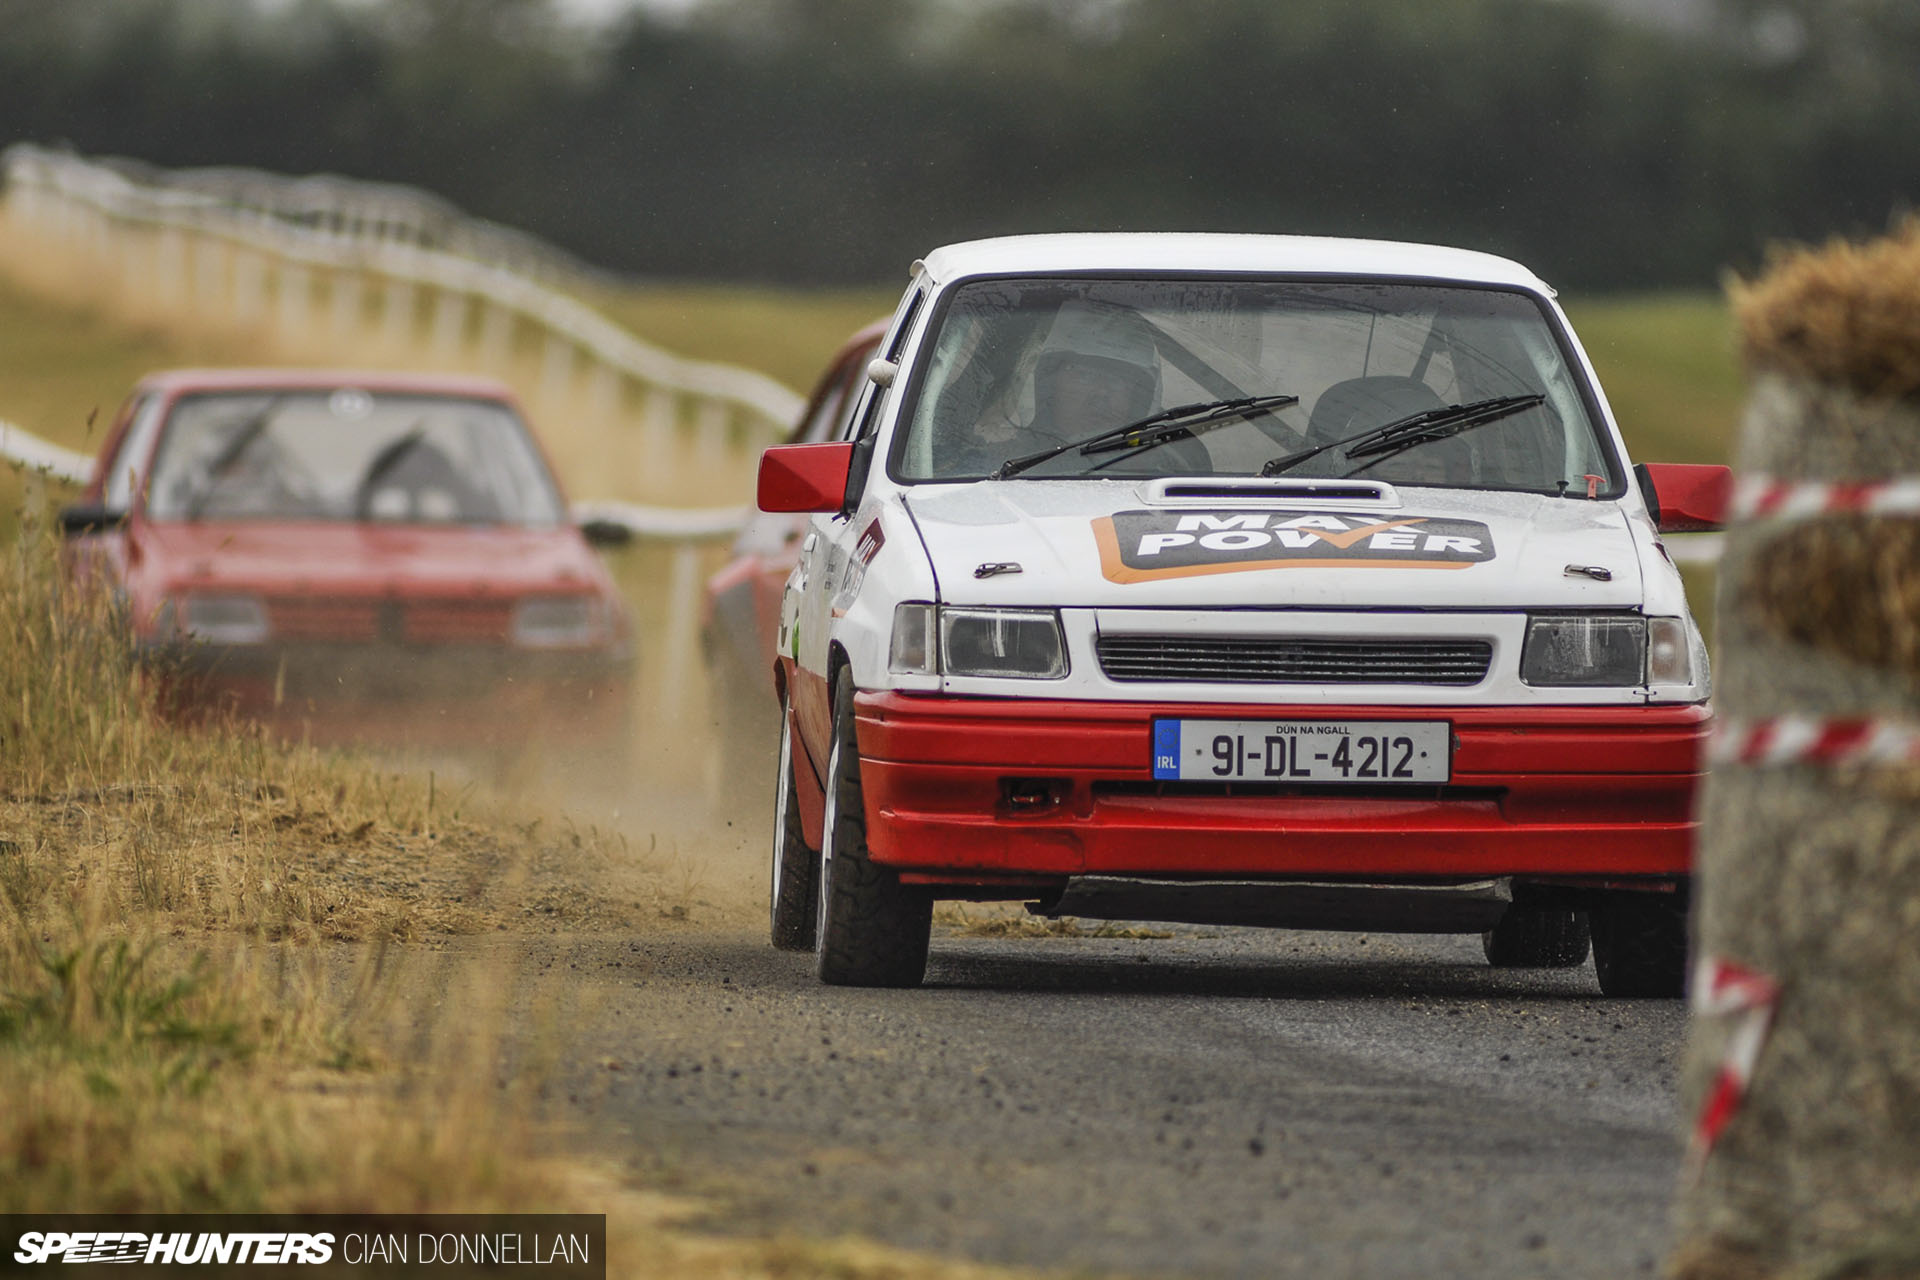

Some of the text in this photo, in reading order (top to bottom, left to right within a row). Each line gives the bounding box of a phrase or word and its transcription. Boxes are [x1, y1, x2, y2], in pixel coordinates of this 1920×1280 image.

[1175, 514, 1428, 534] MAX
[1137, 530, 1484, 556] POWER
[1276, 725, 1350, 735] DÚN NA NGALL
[1157, 756, 1177, 769] IRL
[1212, 735, 1414, 778] 91-DL-4212
